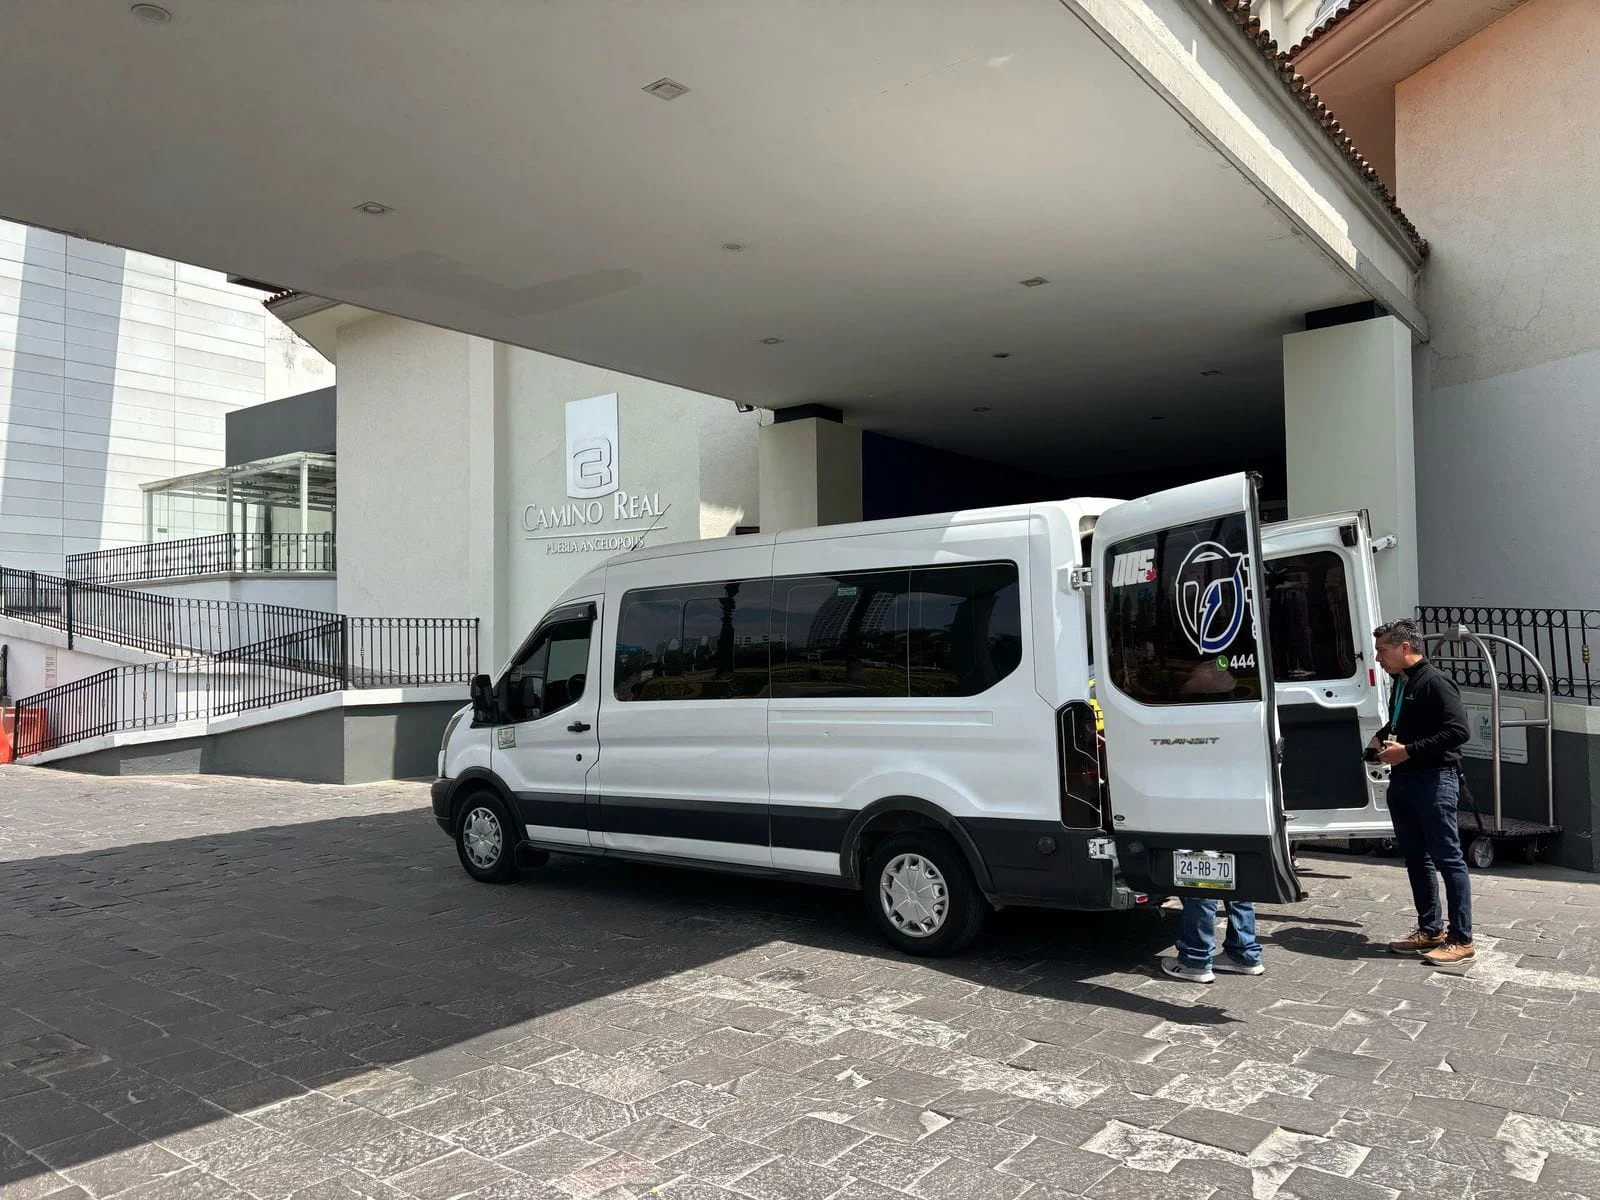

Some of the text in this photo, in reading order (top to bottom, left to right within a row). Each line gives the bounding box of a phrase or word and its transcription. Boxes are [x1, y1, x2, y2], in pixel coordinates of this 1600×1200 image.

[523, 491, 664, 532] CAMINO REAL
[1230, 653, 1255, 669] 444
[1150, 736, 1220, 746] TRANSIT
